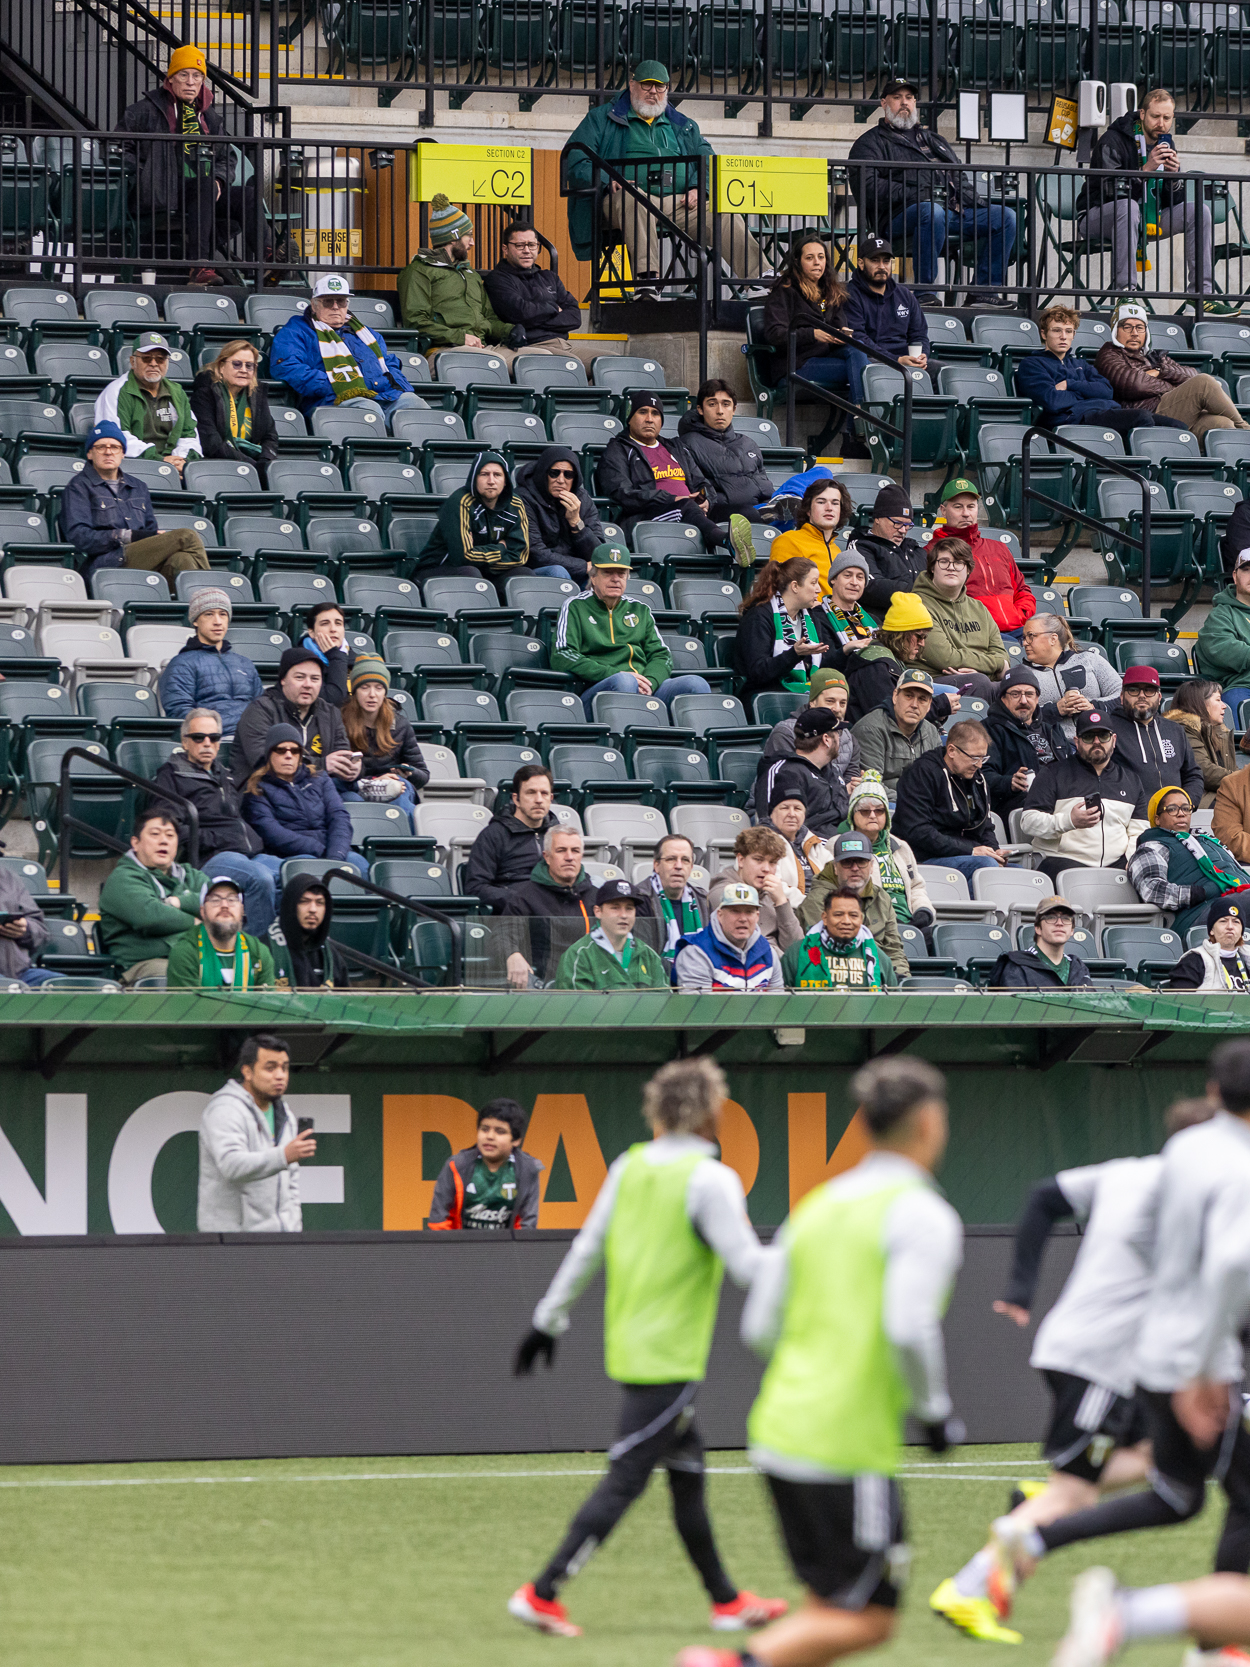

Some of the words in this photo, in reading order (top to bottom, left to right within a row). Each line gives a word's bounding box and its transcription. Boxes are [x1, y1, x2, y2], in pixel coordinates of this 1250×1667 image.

[486, 148, 515, 158] SECTION
[516, 150, 526, 158] C2
[726, 158, 754, 168] SECTION
[755, 160, 763, 168] C1
[491, 169, 525, 198] C2
[726, 178, 756, 207] C1
[327, 243, 341, 253] BN
[875, 240, 884, 248] P
[849, 971, 864, 984] US
